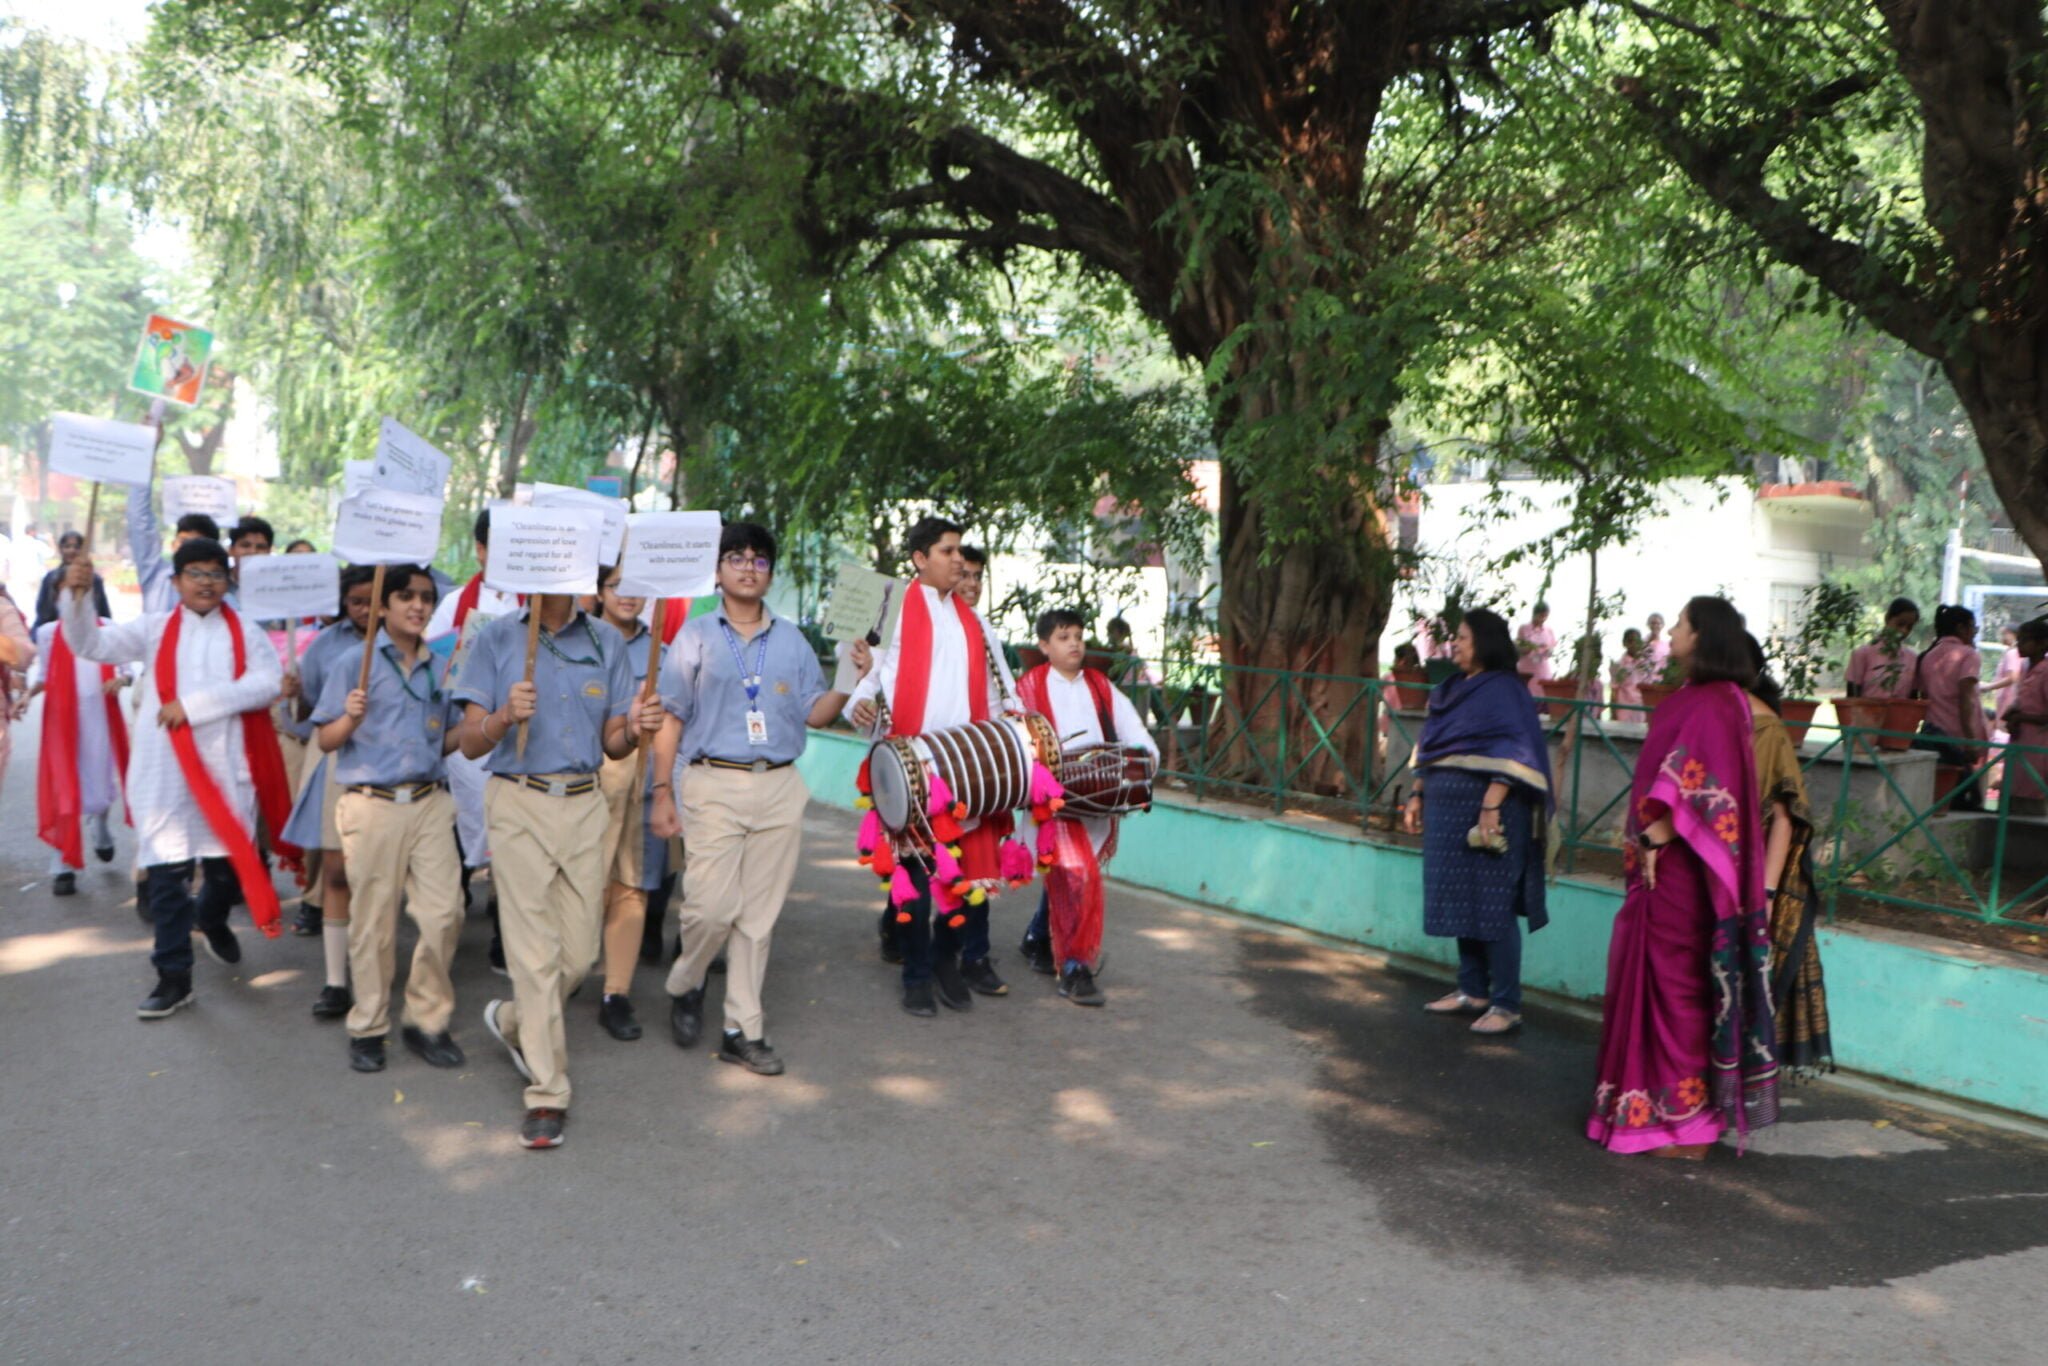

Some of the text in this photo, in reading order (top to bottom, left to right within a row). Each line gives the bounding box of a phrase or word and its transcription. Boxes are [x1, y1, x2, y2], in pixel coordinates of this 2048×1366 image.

[510, 536, 577, 547] expression of love
[508, 550, 573, 561] and regard for all
[648, 553, 665, 564] with
[529, 564, 557, 573] around
